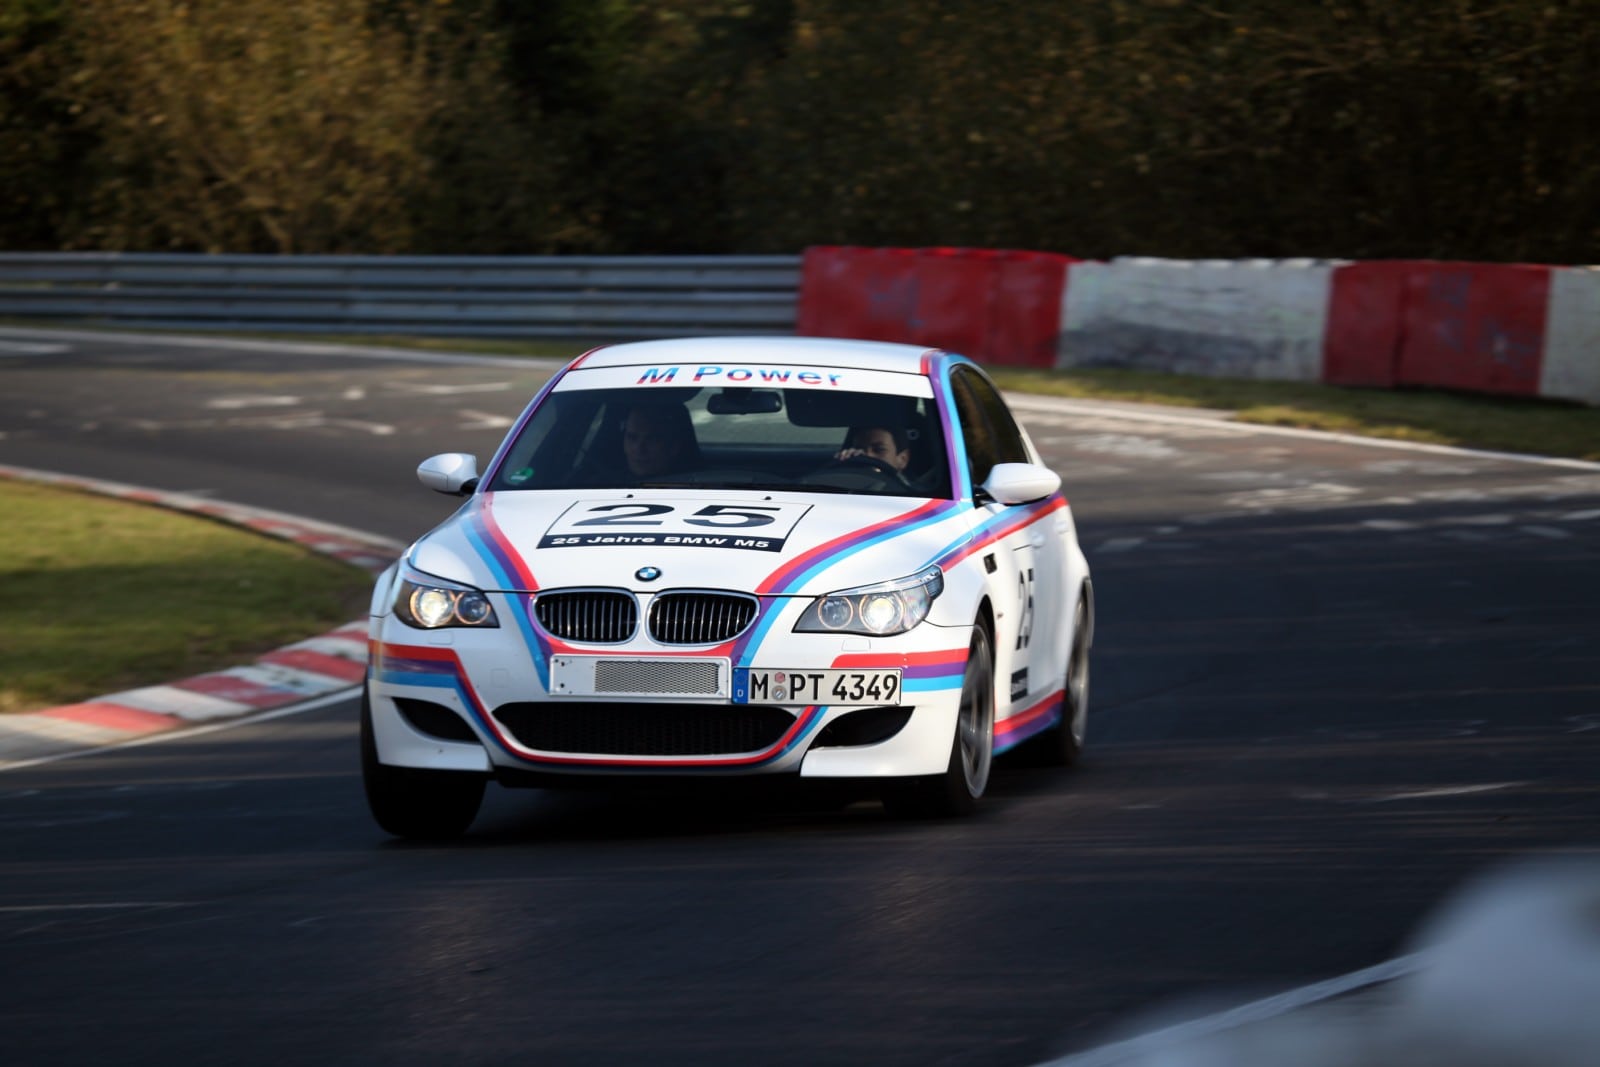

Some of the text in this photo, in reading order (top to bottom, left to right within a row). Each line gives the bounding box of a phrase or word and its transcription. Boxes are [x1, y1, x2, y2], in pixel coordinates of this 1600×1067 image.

[636, 366, 843, 386] M Power
[572, 503, 782, 528] 25
[551, 535, 770, 548] 25 Jahre BMW M5
[751, 673, 898, 701] M PT 4349
